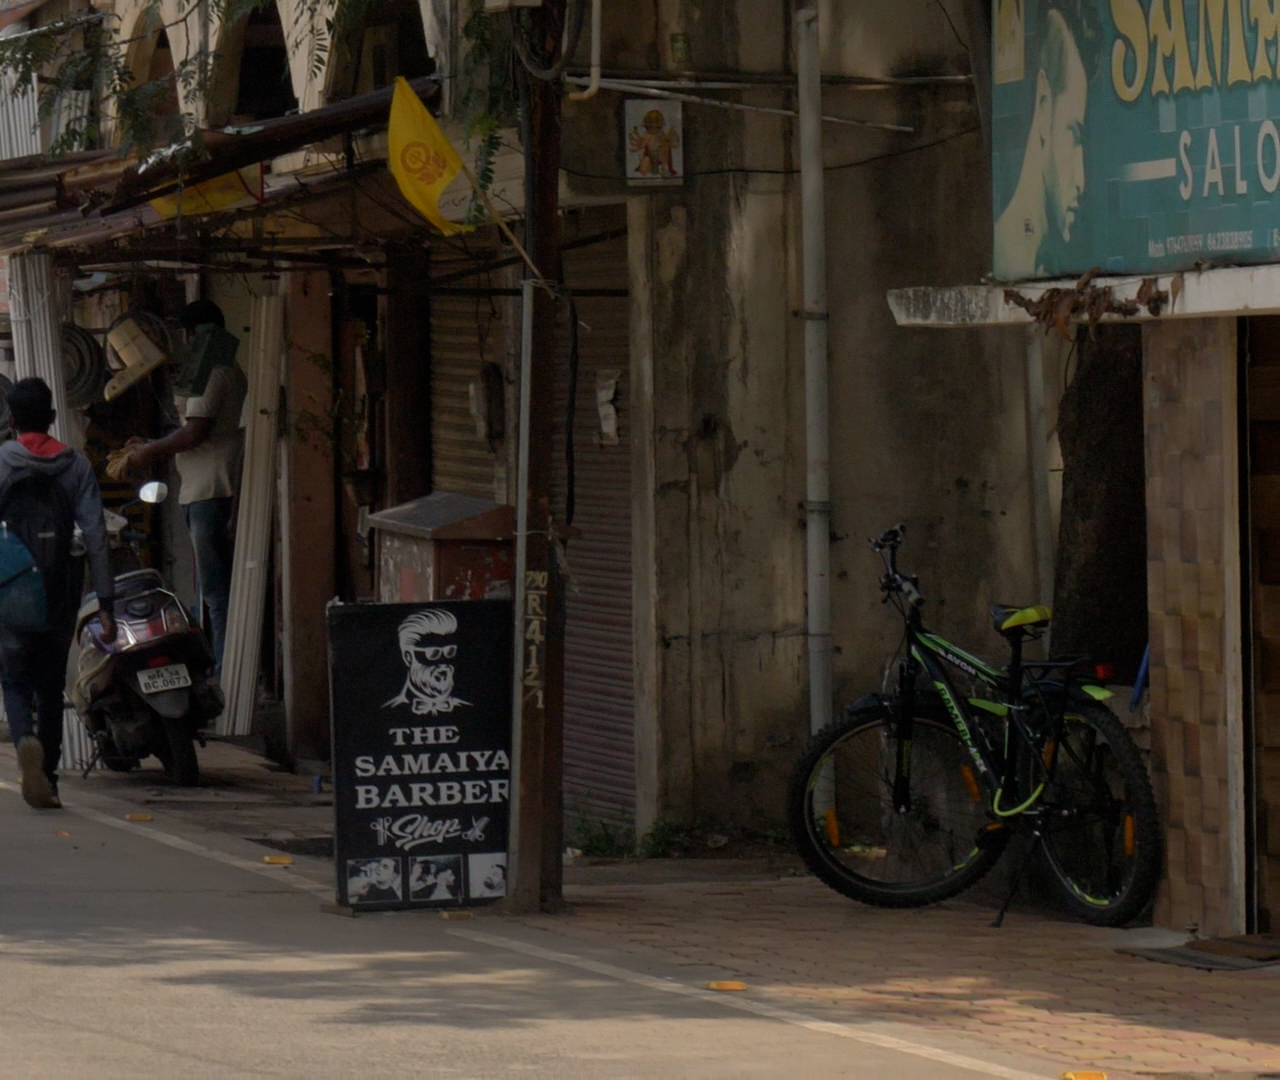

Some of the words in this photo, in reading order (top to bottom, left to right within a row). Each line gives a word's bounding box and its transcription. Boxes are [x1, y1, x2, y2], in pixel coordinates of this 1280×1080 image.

[1178, 120, 1280, 201] SALO
[389, 726, 460, 746] THE
[355, 750, 510, 777] SAMAIYA
[355, 779, 510, 809] BARBER
[391, 814, 462, 851] Shop
